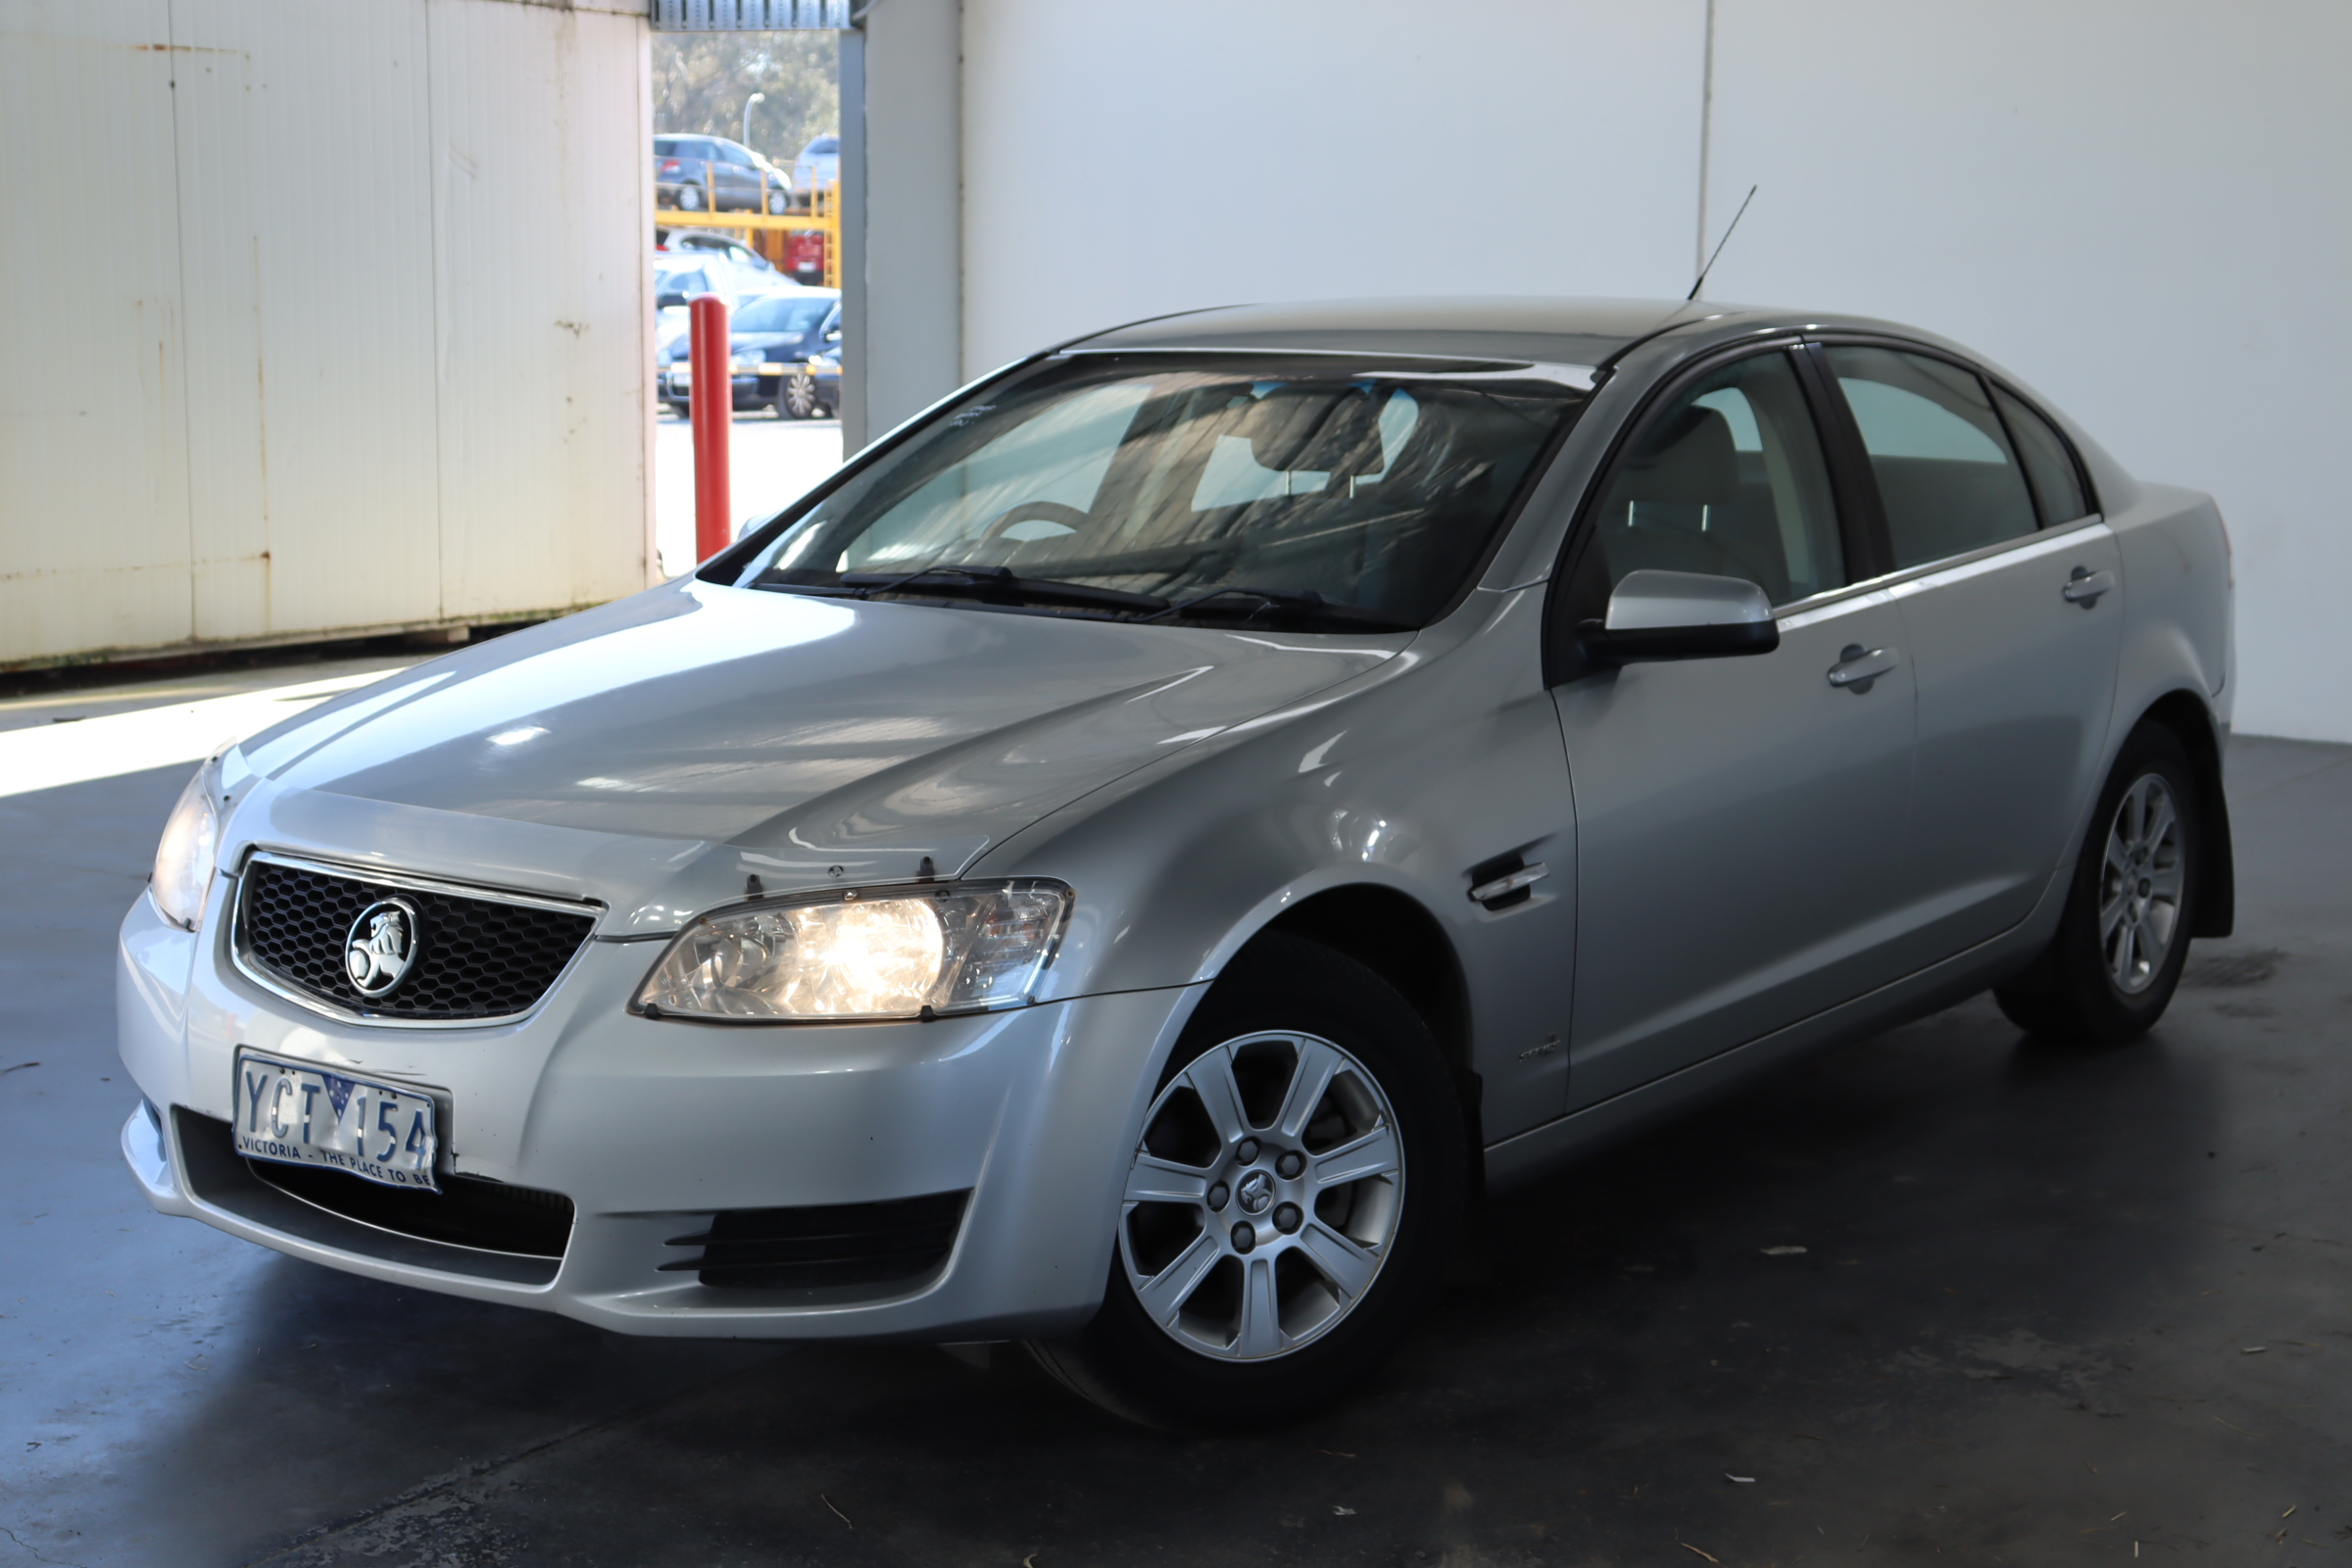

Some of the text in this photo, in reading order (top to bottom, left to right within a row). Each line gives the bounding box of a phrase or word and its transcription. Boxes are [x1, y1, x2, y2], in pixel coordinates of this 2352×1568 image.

[245, 1070, 426, 1170] YCT 154
[243, 1136, 301, 1159] VICTORIA
[320, 1149, 345, 1165] THE
[349, 1156, 383, 1179] PLACE
[387, 1168, 407, 1183] TO
[412, 1173, 431, 1186] BE
